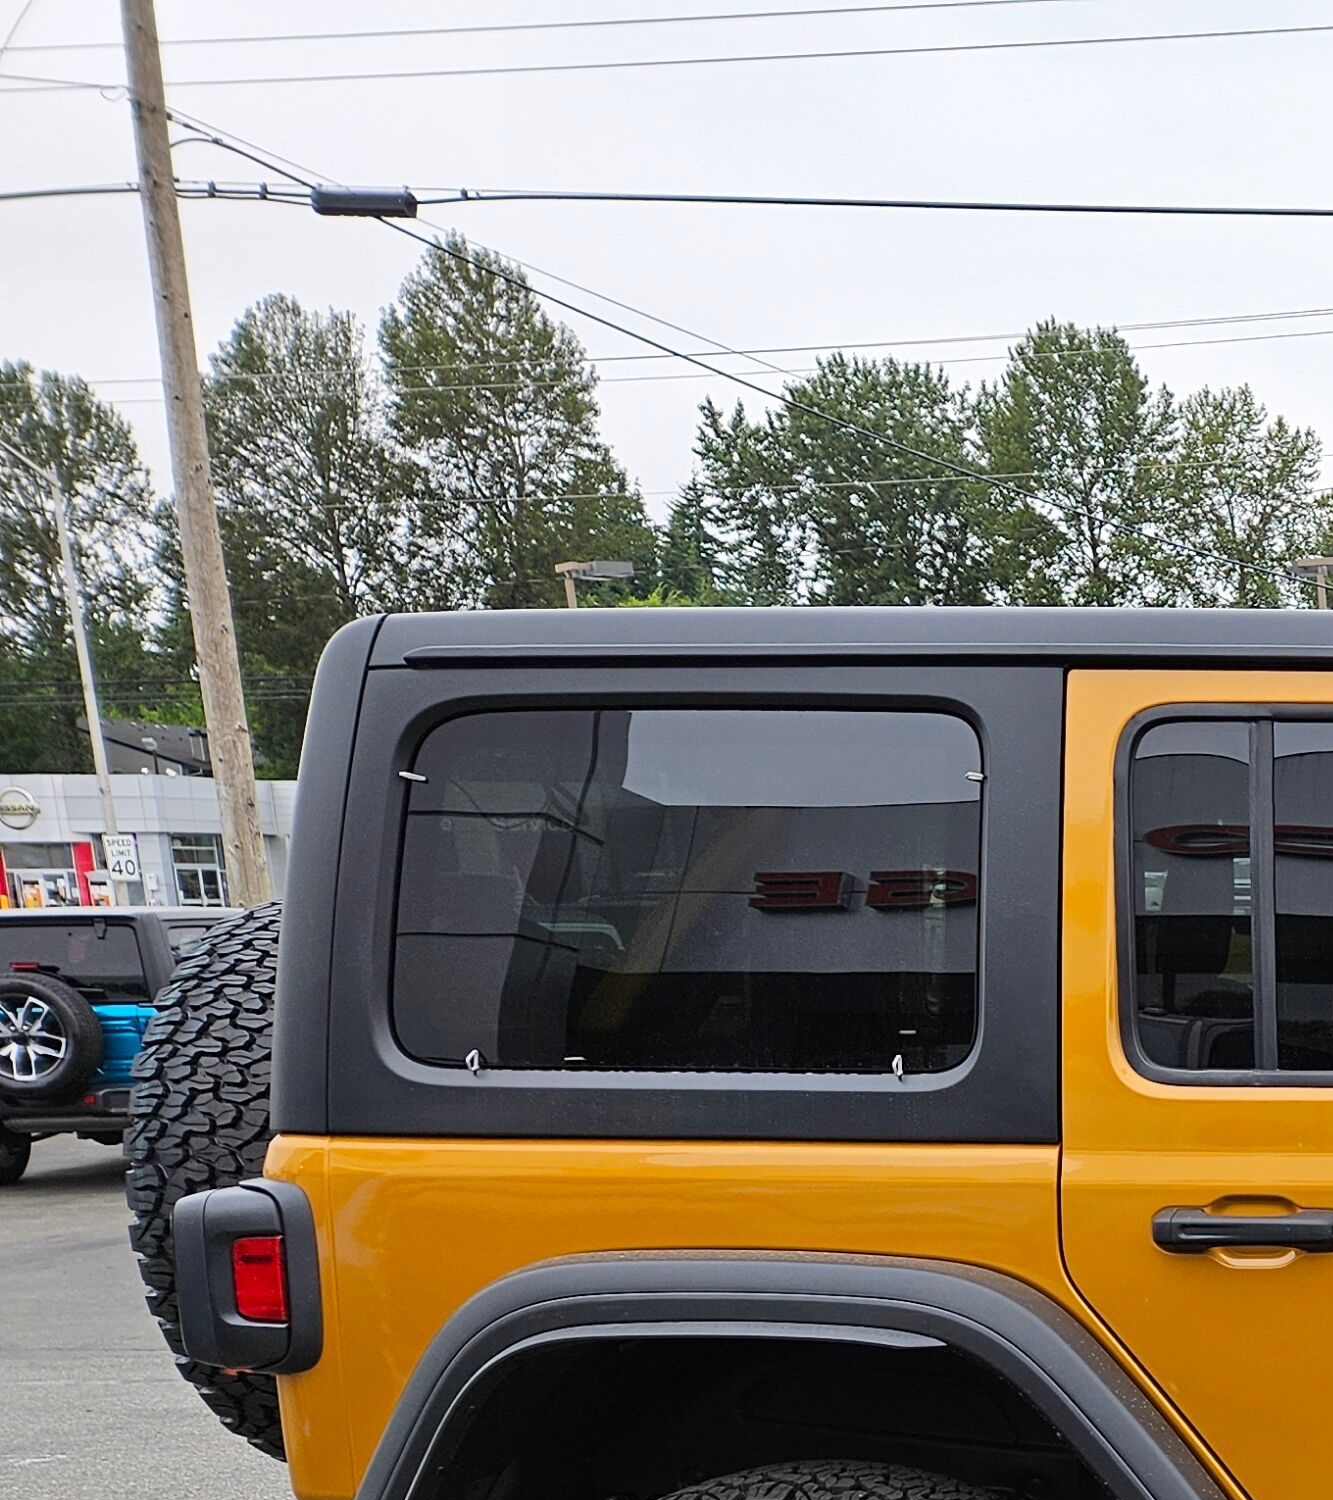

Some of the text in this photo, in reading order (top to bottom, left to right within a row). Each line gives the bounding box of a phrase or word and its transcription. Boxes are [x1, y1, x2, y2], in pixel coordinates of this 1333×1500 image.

[106, 839, 132, 847] SPEED
[111, 849, 131, 857] LIMIT
[112, 860, 136, 876] 40
